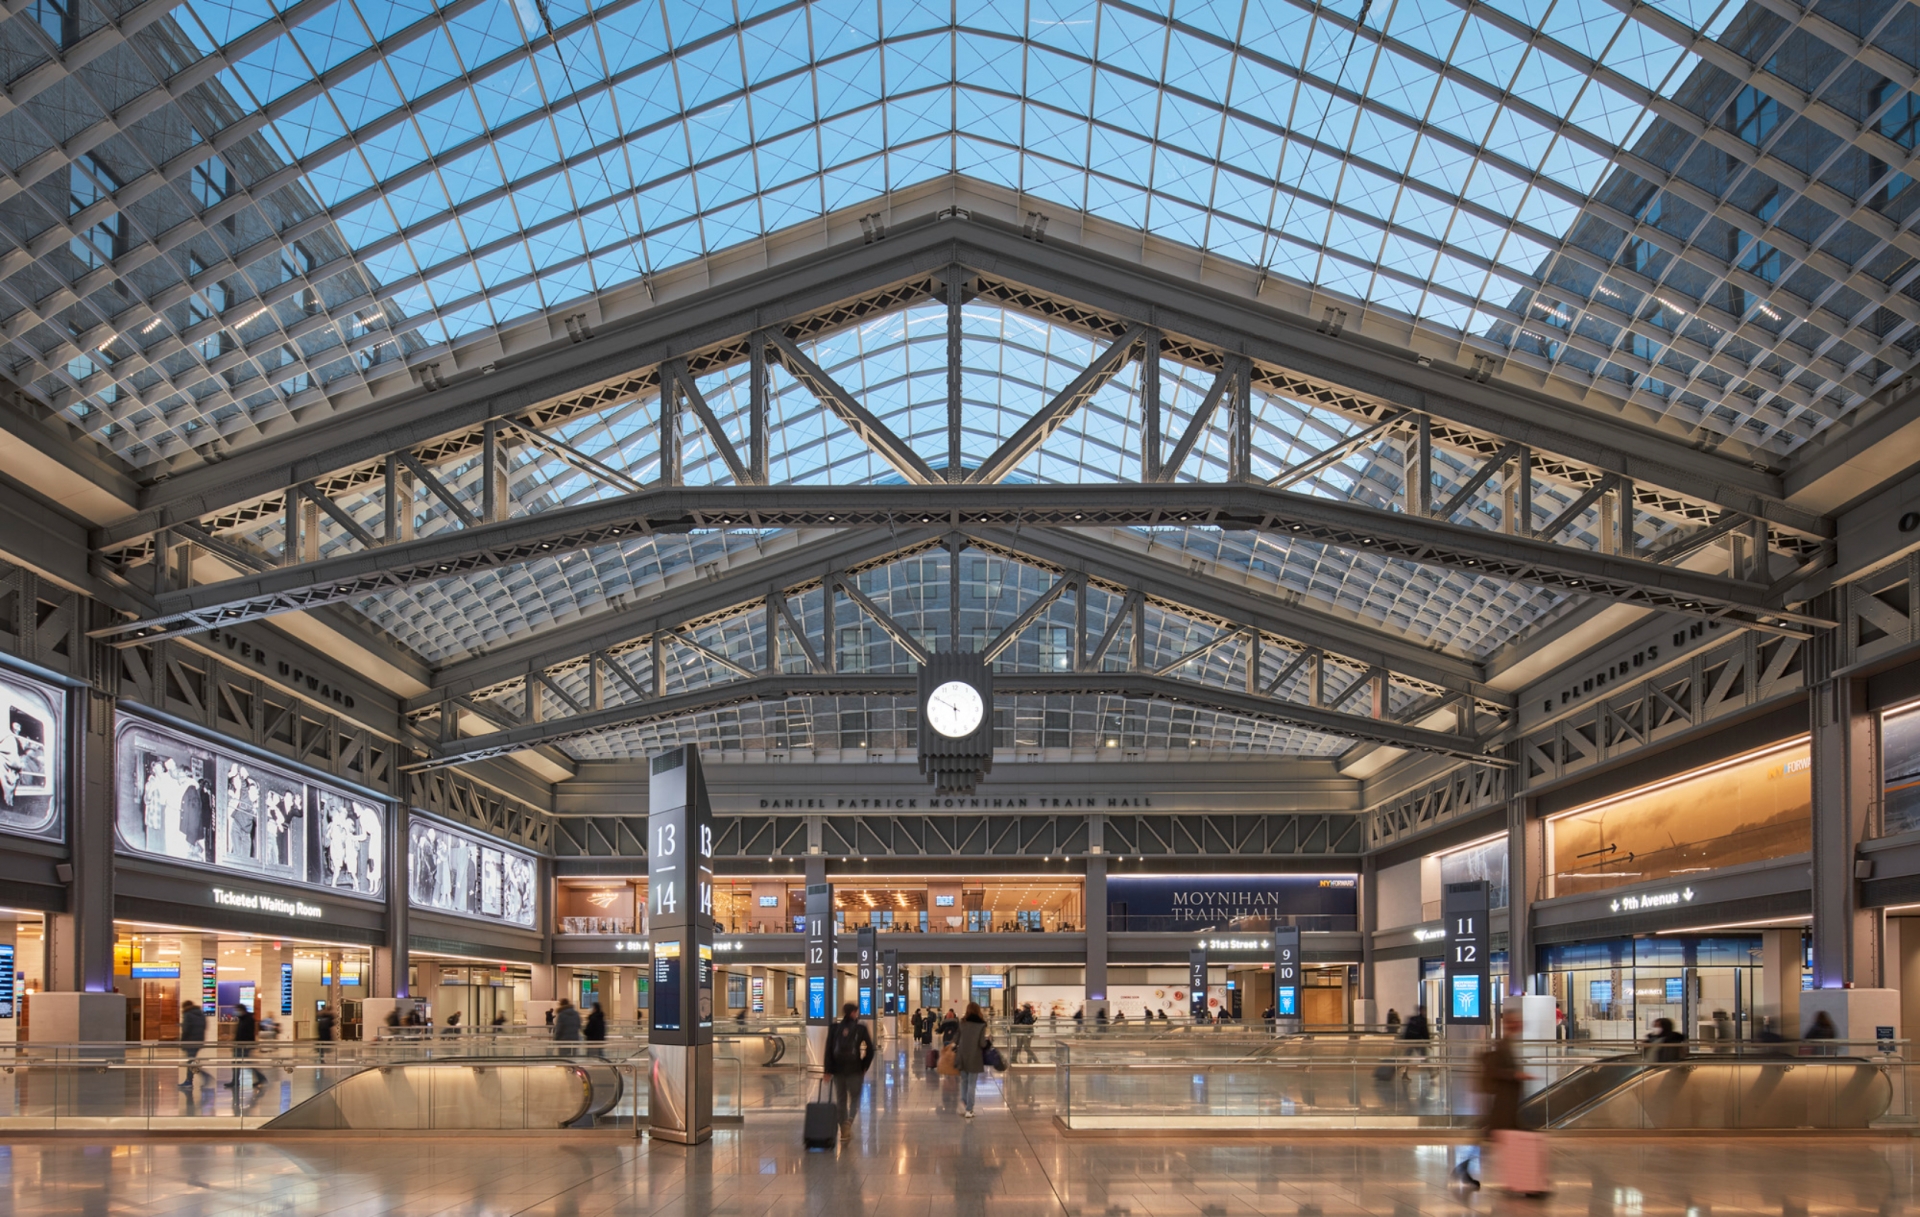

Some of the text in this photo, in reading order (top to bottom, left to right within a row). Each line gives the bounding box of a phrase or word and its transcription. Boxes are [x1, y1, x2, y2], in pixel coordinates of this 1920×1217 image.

[210, 628, 355, 709] EVER UPWARD
[1544, 699, 1552, 713] E
[1561, 645, 1659, 705] PLURIBUS
[760, 798, 1152, 808] DANIEL PATRICK MOYNIHAN TRAIN HALL
[656, 823, 676, 857] 13
[700, 823, 712, 858] 13
[212, 888, 322, 918] Ticketed Waiting Room
[656, 881, 676, 916] 14
[700, 881, 712, 916] 14
[1173, 892, 1279, 905] MOYNIHAN
[1622, 892, 1679, 910] 9th Avenue
[1172, 908, 1282, 921] TRAIN HALL
[812, 920, 821, 936] 11
[1457, 918, 1473, 934] 11
[627, 942, 641, 950] 8th
[1210, 940, 1258, 949] 31st Street
[810, 948, 822, 964] 12
[862, 950, 868, 961] 9
[1283, 949, 1291, 960] 9
[1455, 945, 1476, 962] 12
[861, 968, 870, 979] 10
[887, 966, 892, 974] 7
[1195, 965, 1200, 973] 7
[1281, 967, 1293, 978] 10
[887, 979, 892, 987] 8
[1195, 978, 1200, 986] 8
